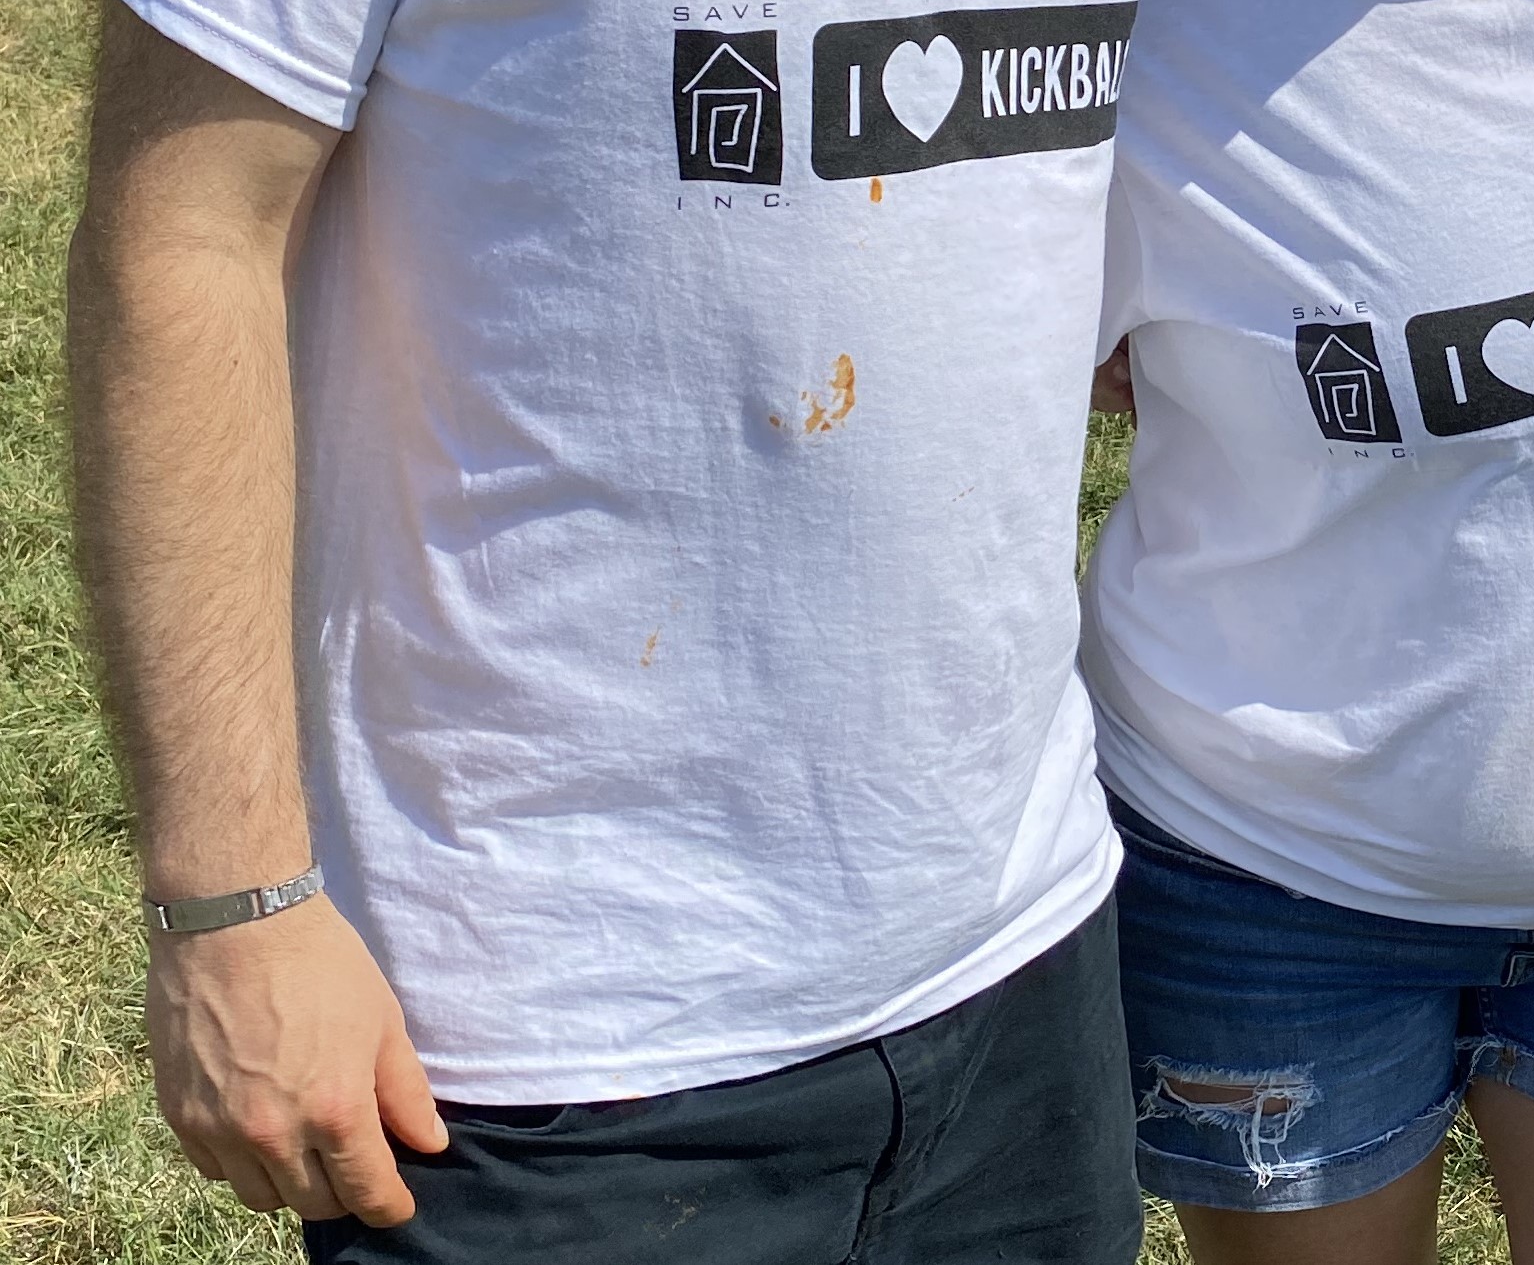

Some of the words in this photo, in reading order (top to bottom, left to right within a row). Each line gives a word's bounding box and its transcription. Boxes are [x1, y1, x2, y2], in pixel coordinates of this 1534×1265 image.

[673, 2, 778, 22] SAVE
[849, 64, 861, 137] I
[677, 193, 790, 210] INC.
[1292, 301, 1369, 320] SAVE
[1444, 345, 1468, 405] I
